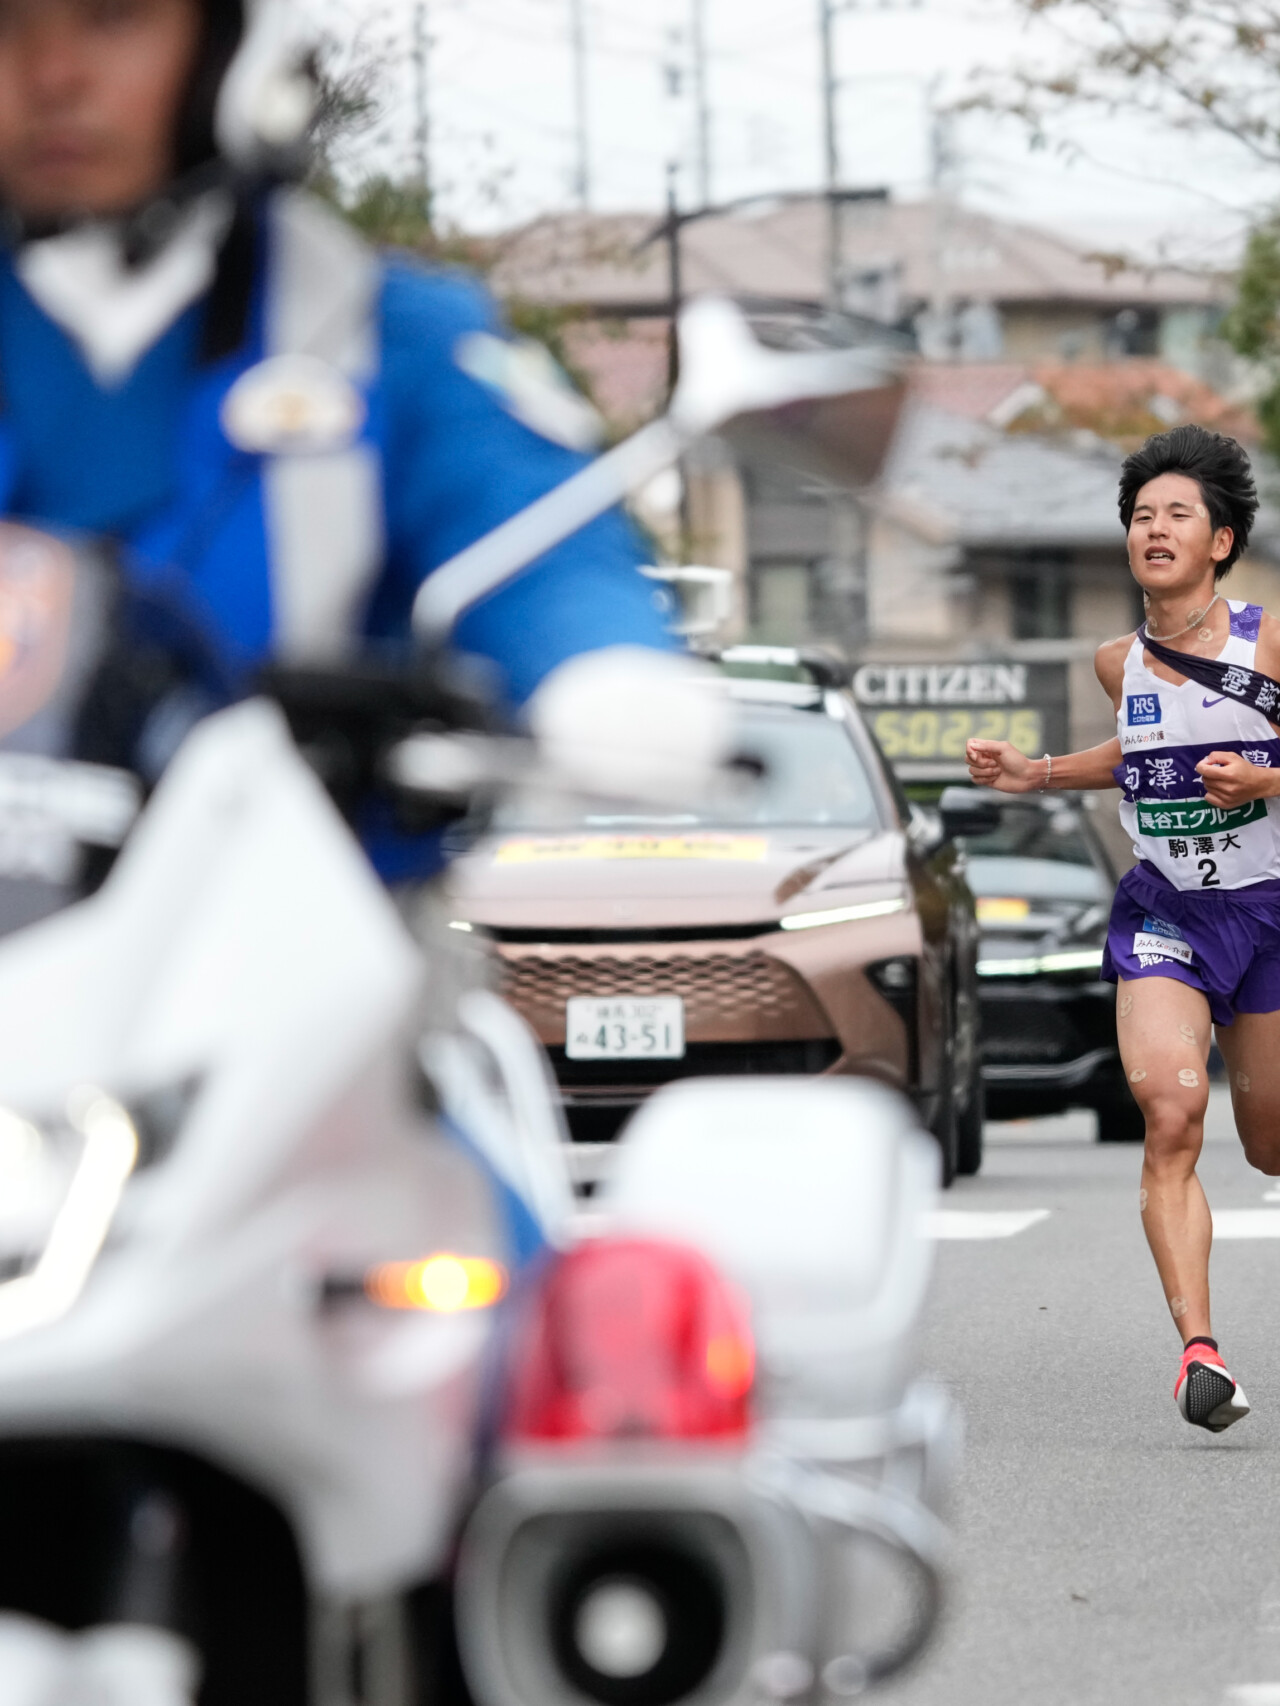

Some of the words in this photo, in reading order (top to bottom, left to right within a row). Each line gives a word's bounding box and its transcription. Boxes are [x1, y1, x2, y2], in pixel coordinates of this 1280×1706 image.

[852, 663, 1026, 703] CITIZEN
[1132, 697, 1155, 714] HRS
[1124, 730, 1165, 745] みんなの介護
[1168, 833, 1242, 859] 駒澤大
[1197, 858, 1221, 887] 2
[594, 1023, 672, 1051] 43-51
